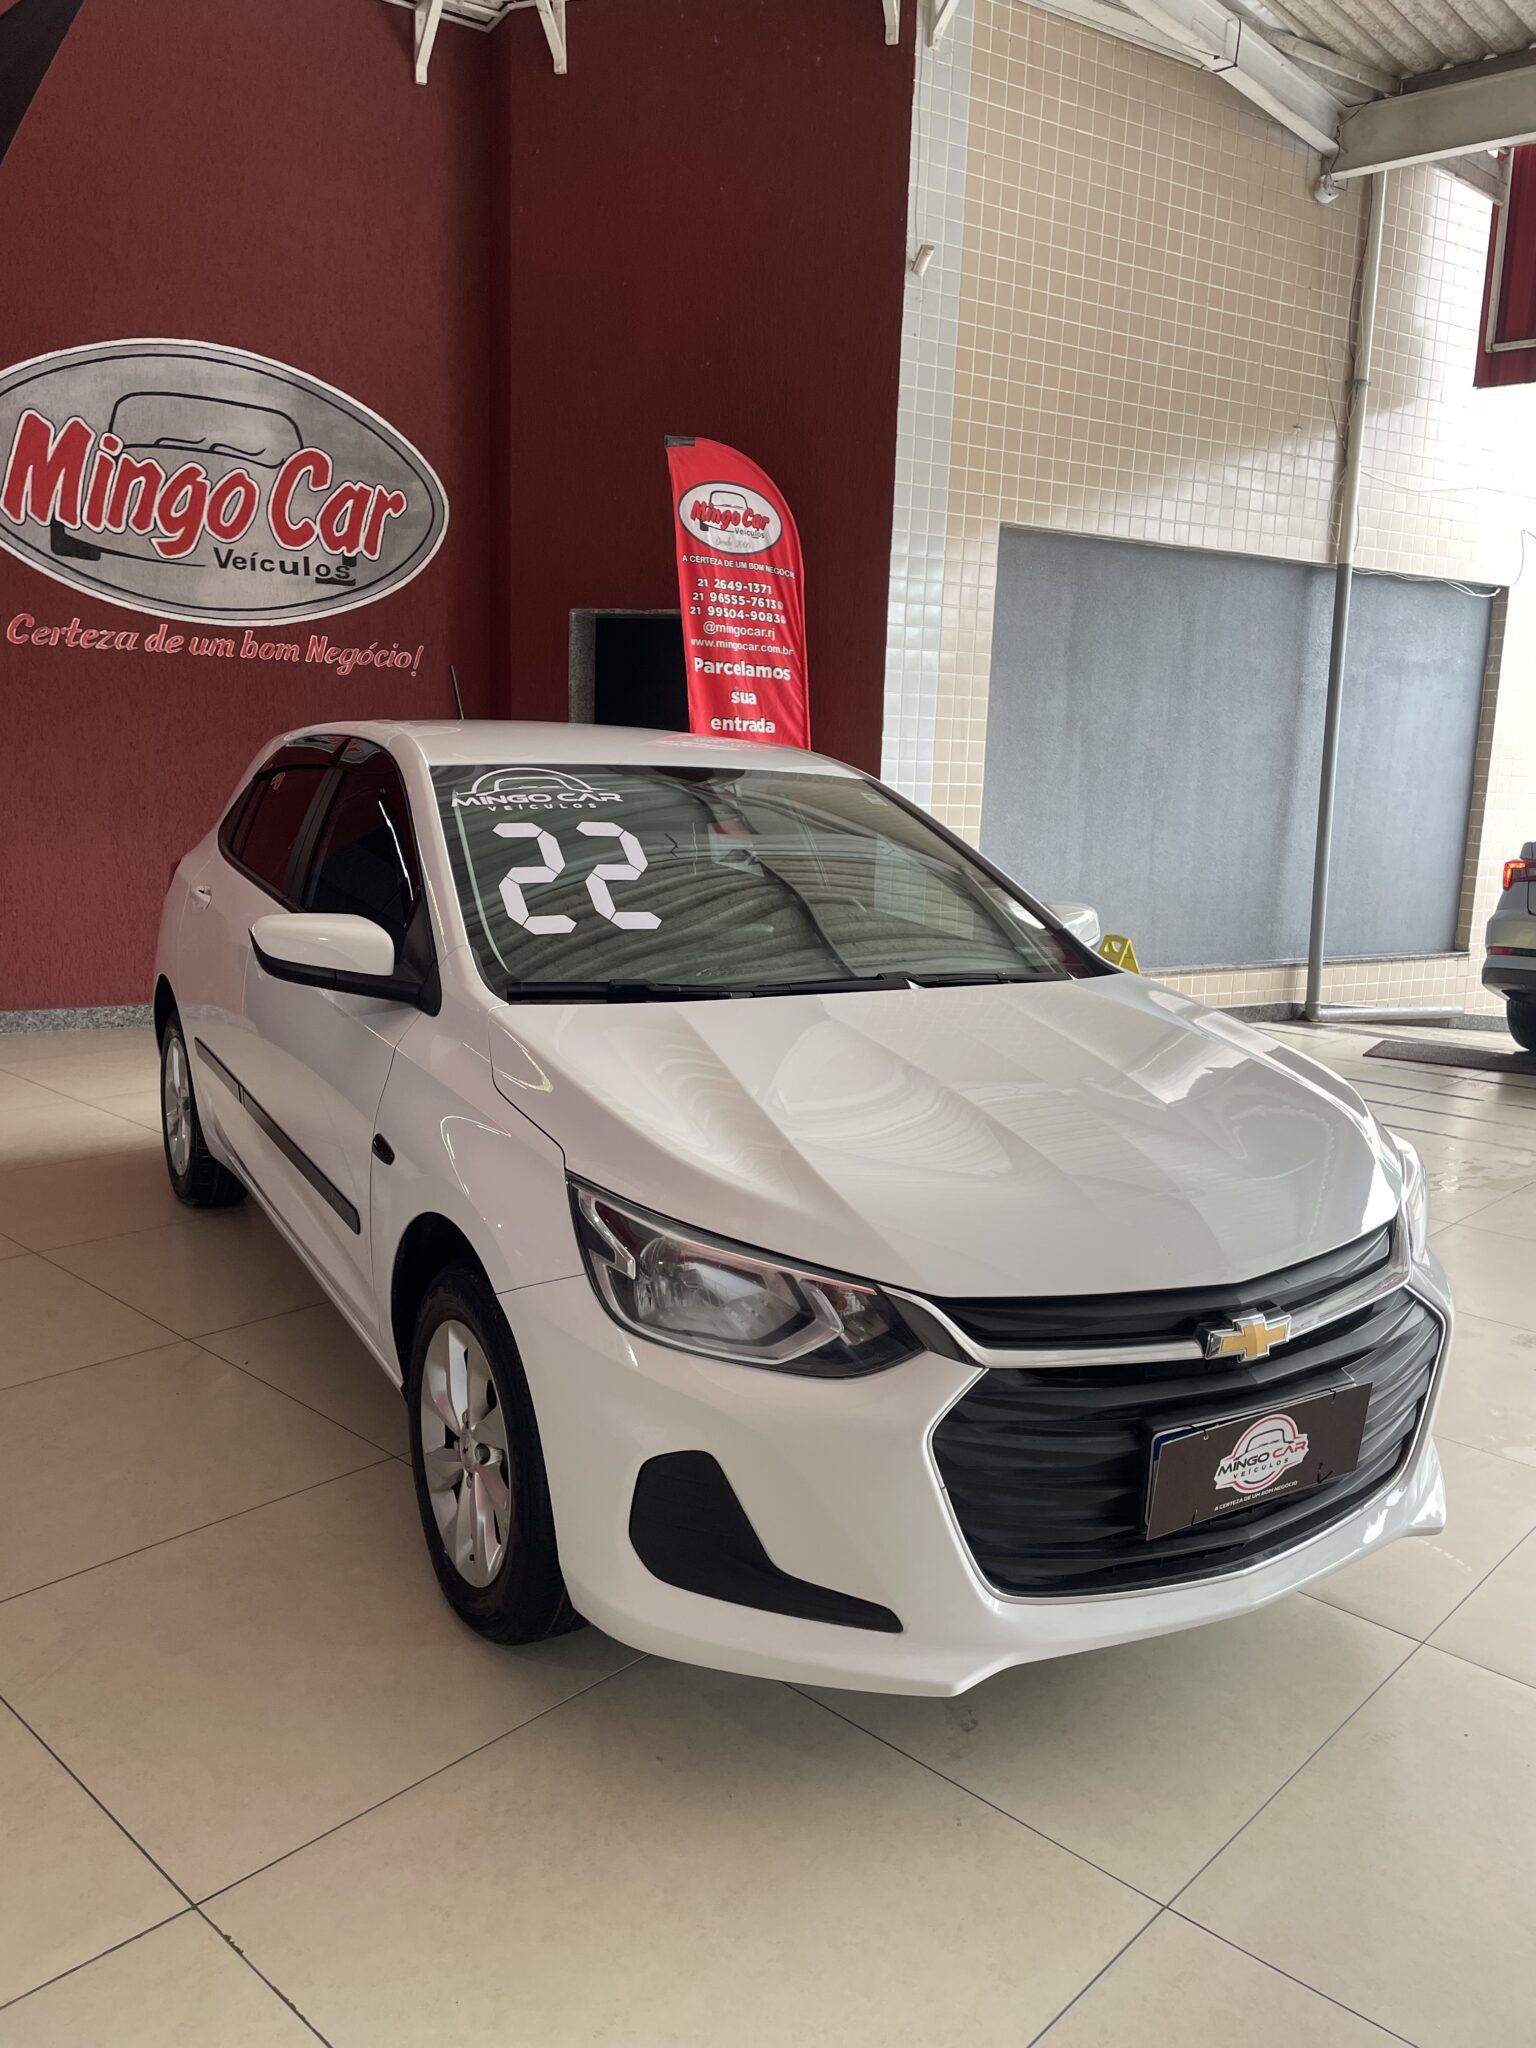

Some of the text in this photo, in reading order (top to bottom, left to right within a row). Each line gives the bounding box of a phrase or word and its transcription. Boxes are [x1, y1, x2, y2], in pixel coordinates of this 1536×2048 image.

[0, 408, 407, 561] Mingo Car
[690, 499, 770, 532] Mingo Car
[213, 547, 351, 579] Veículos
[682, 554, 688, 562] A
[690, 555, 723, 567] CERTEZA
[724, 559, 734, 568] DE
[736, 561, 748, 569] UM
[749, 562, 765, 571] BOM
[697, 578, 772, 595] 21 2649-1371
[692, 592, 777, 610] 21 96555-7613
[690, 606, 780, 624] 21 99504-9083
[703, 620, 776, 640] @mingocar.rj
[6, 612, 425, 677] Certeza de um bom Negócio!
[690, 637, 794, 656] www.mingocar.com.br
[693, 656, 791, 681] Parcelamos
[731, 690, 757, 705] sua
[710, 716, 776, 734] entrada
[451, 792, 624, 807] MINGO CAR
[487, 803, 597, 811] VEÍCULOS
[492, 821, 663, 936] 22
[1217, 1441, 1307, 1476] MINGO CAR
[1233, 1457, 1289, 1478] VEÍCULOS
[1219, 1497, 1243, 1510] CERTEZA
[1261, 1487, 1273, 1496] BOM
